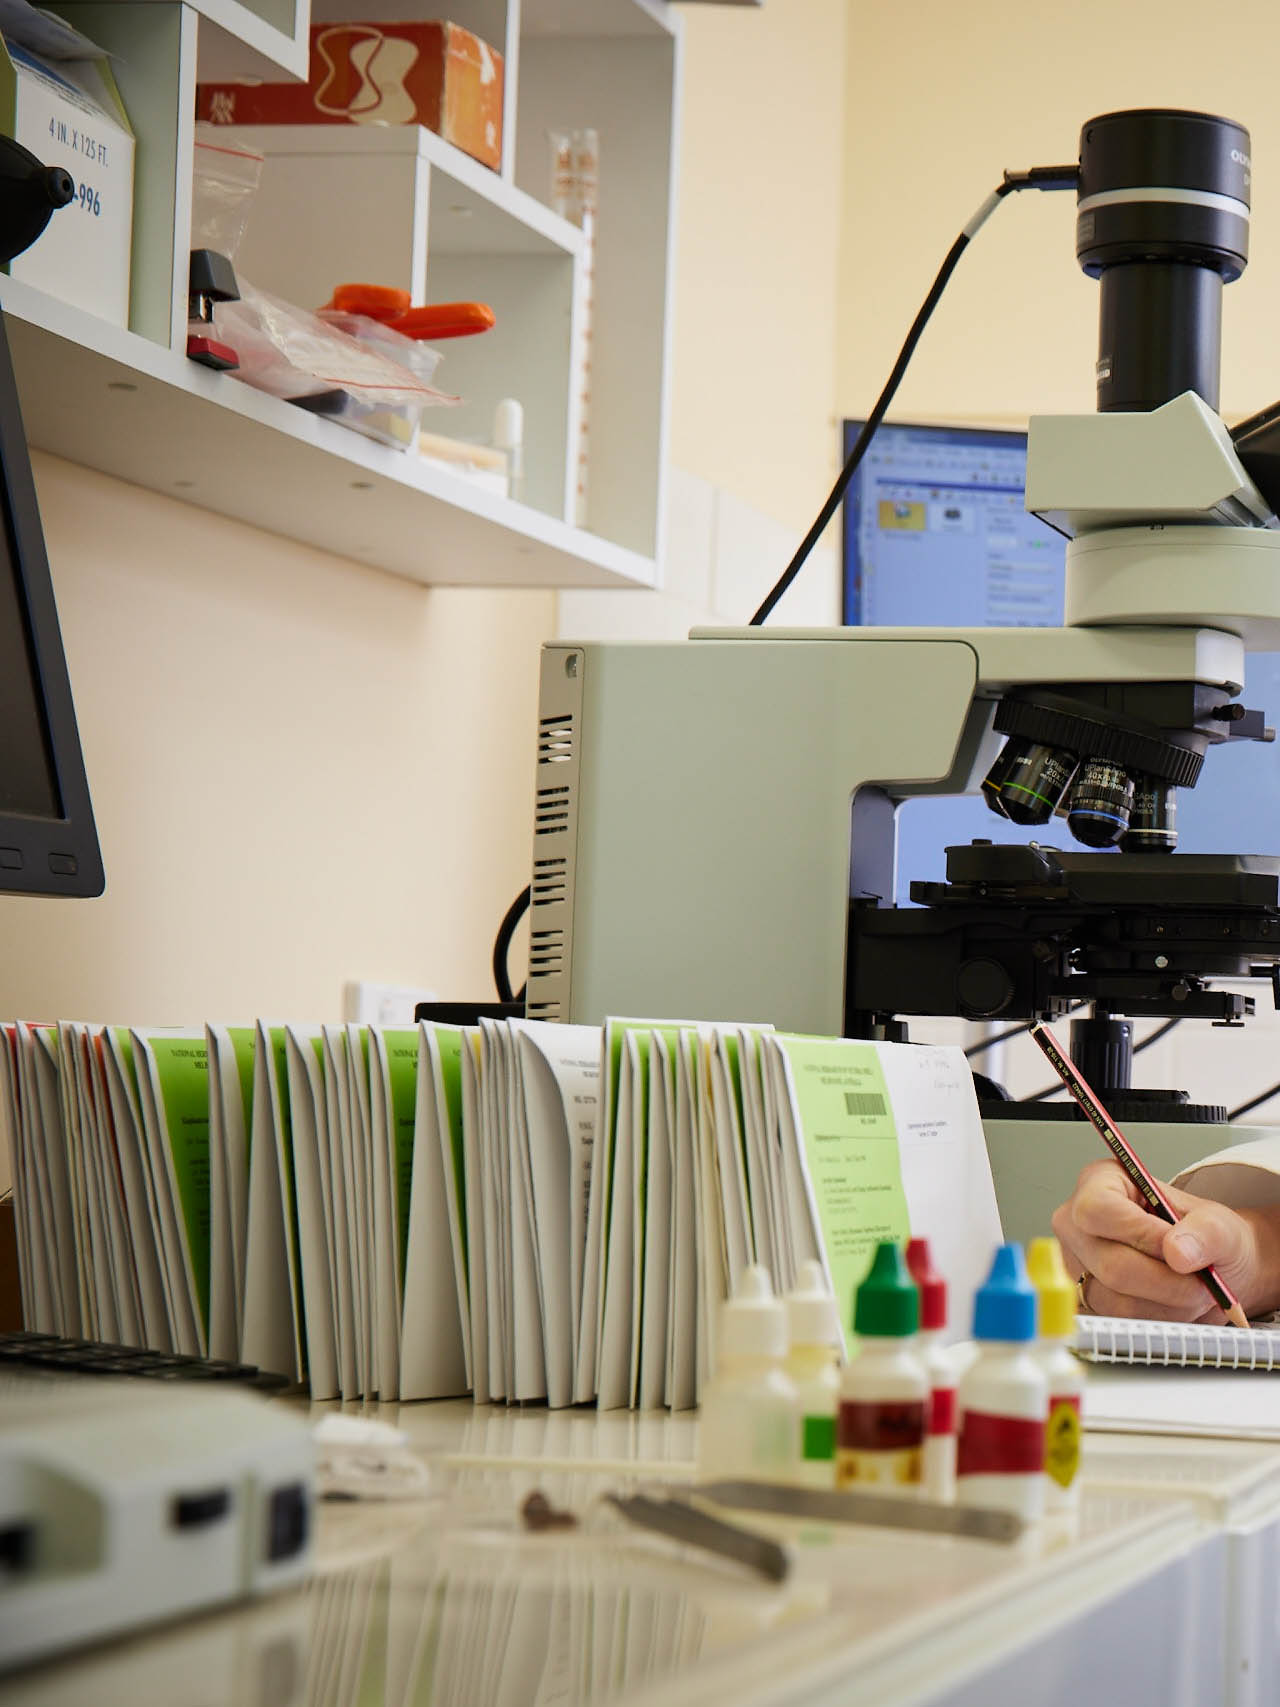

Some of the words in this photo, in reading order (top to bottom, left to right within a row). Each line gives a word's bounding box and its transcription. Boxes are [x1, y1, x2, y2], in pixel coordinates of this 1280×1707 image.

[49, 116, 55, 137] 4
[57, 121, 69, 146] IN.
[72, 129, 78, 151] X
[81, 134, 96, 160] 125
[98, 144, 109, 168] FT.
